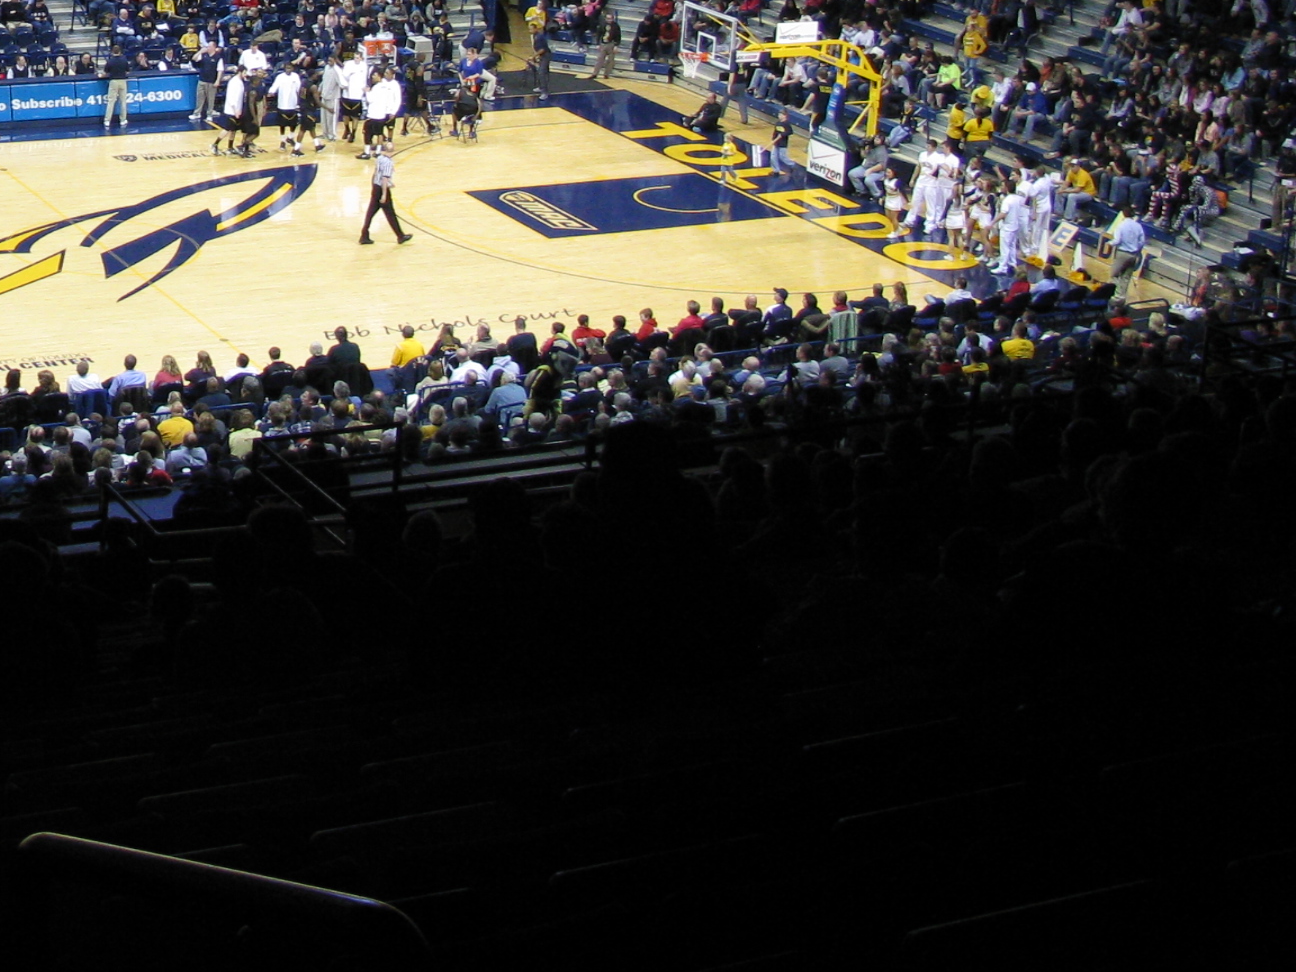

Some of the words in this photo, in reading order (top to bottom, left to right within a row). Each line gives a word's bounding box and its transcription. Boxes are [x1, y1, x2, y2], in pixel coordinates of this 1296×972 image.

[11, 96, 83, 110] Subscribe
[809, 159, 842, 183] verizon
[621, 121, 980, 270] TOLEDO
[1051, 226, 1074, 247] E
[19, 356, 95, 370] CENTER
